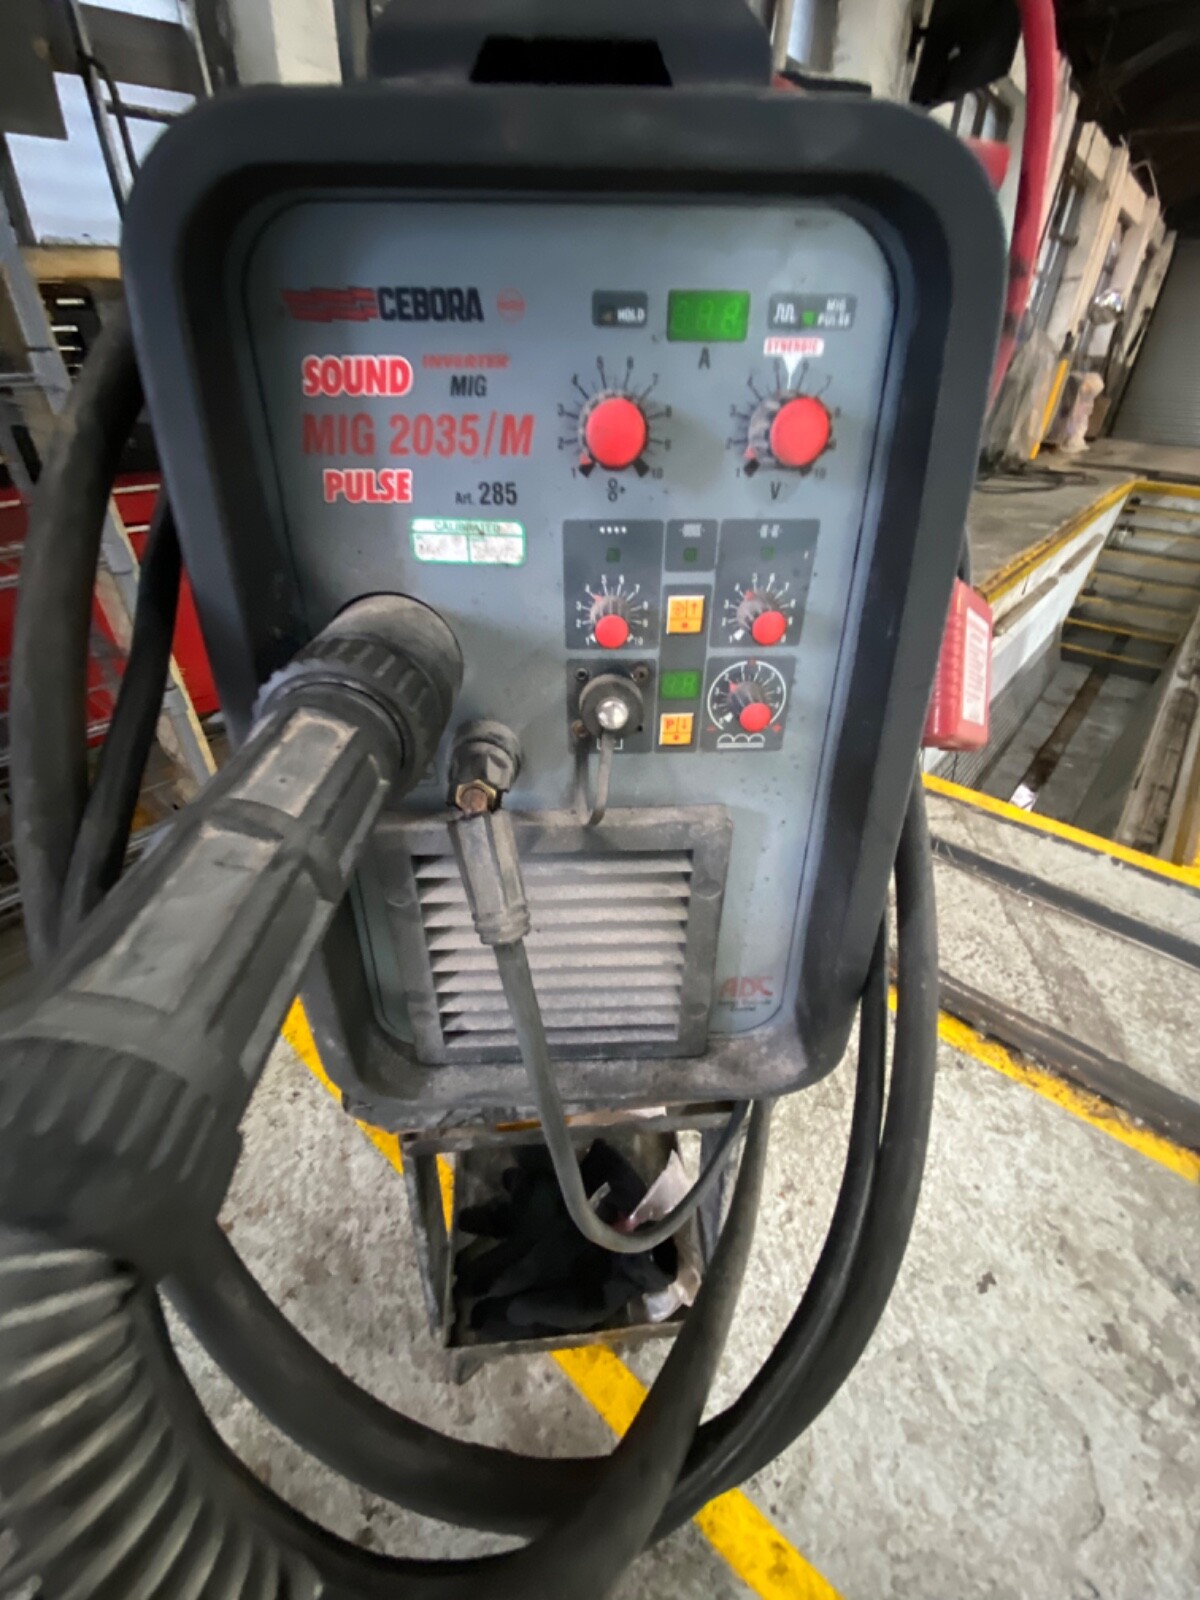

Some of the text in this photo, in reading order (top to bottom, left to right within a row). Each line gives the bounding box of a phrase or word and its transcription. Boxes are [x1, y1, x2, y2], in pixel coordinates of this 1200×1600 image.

[376, 287, 484, 322] CEBORA
[617, 307, 646, 322] HOLD
[698, 347, 711, 370] A
[302, 355, 413, 397] SOUND
[449, 375, 487, 397] MIG
[301, 410, 537, 459] MIG 2035/M
[323, 468, 413, 503] PULSE
[477, 481, 519, 505] 285
[770, 481, 783, 501] V
